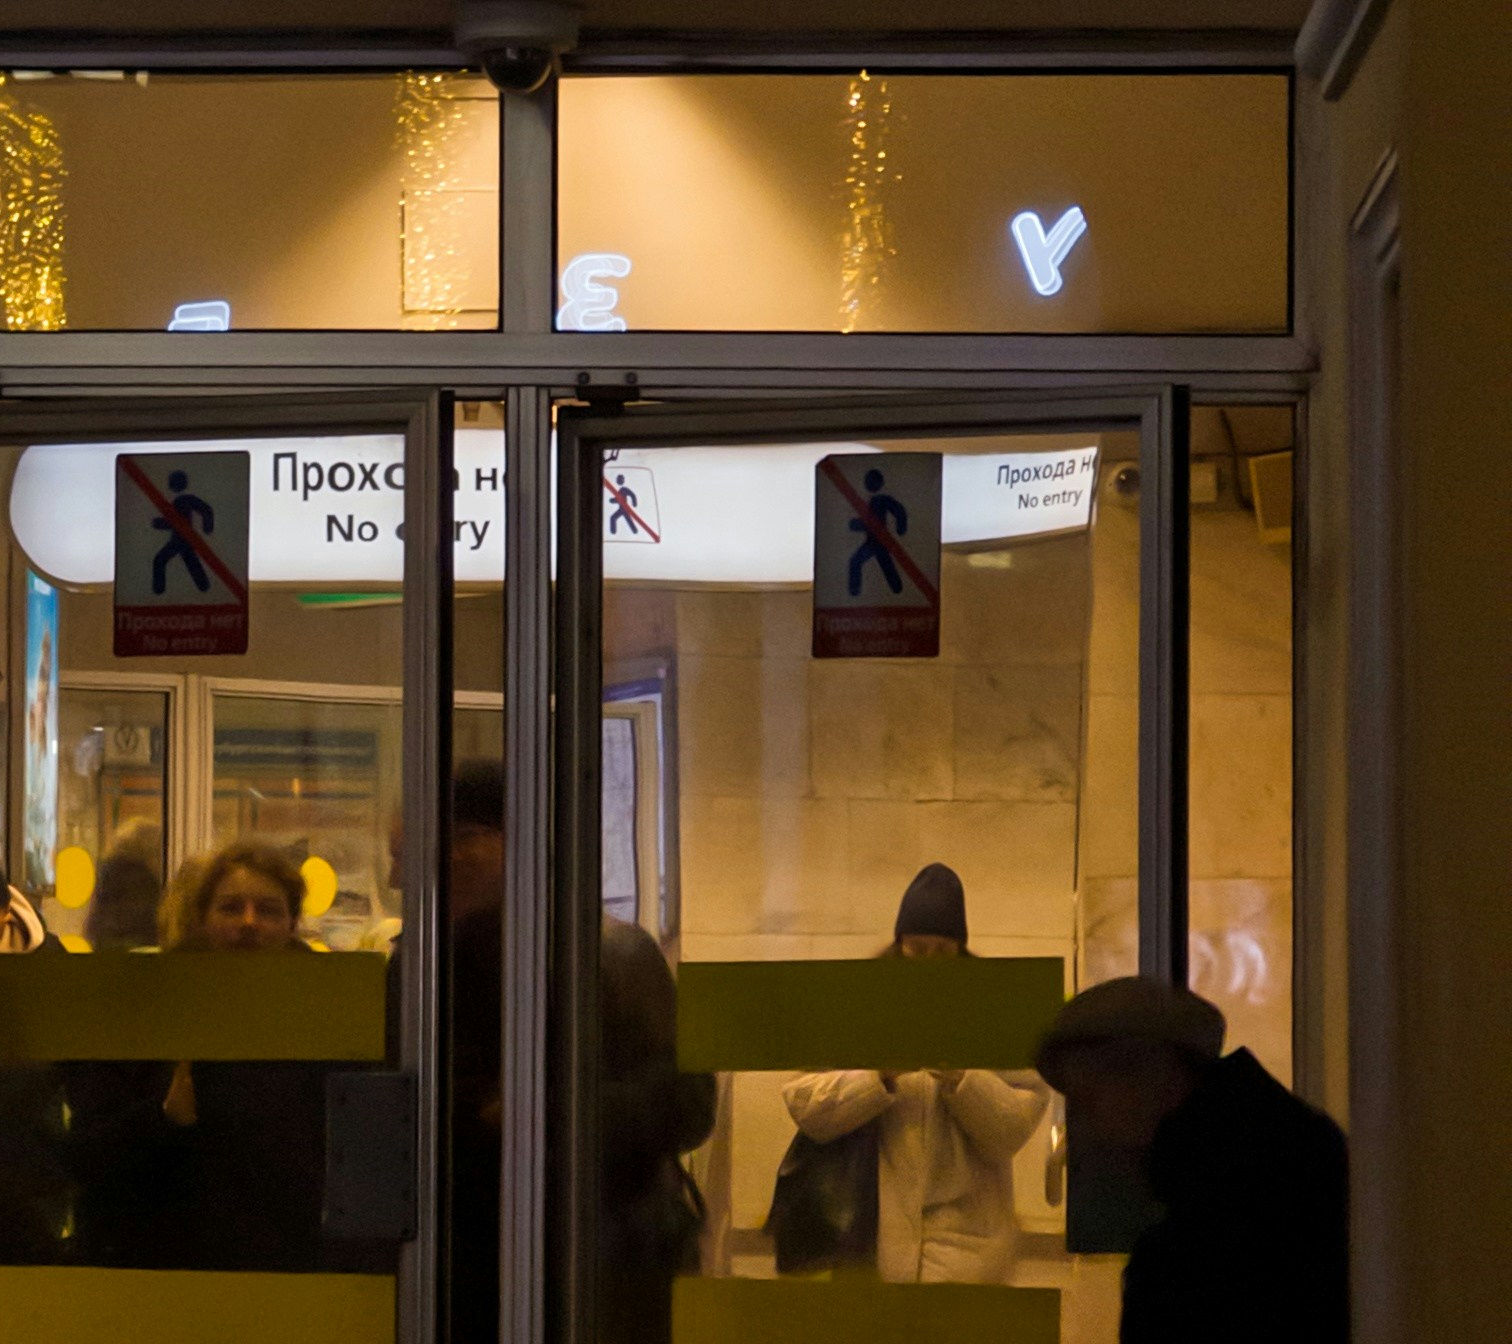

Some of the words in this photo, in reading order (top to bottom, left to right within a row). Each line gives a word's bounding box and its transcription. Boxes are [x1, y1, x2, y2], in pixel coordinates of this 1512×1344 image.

[996, 458, 1076, 490] Прохода
[1017, 493, 1039, 510] No
[1042, 489, 1084, 508] entry
[326, 514, 381, 543] No
[119, 612, 206, 635] Прохода
[210, 612, 242, 630] нет
[141, 635, 168, 650] No
[171, 635, 217, 652] entry
